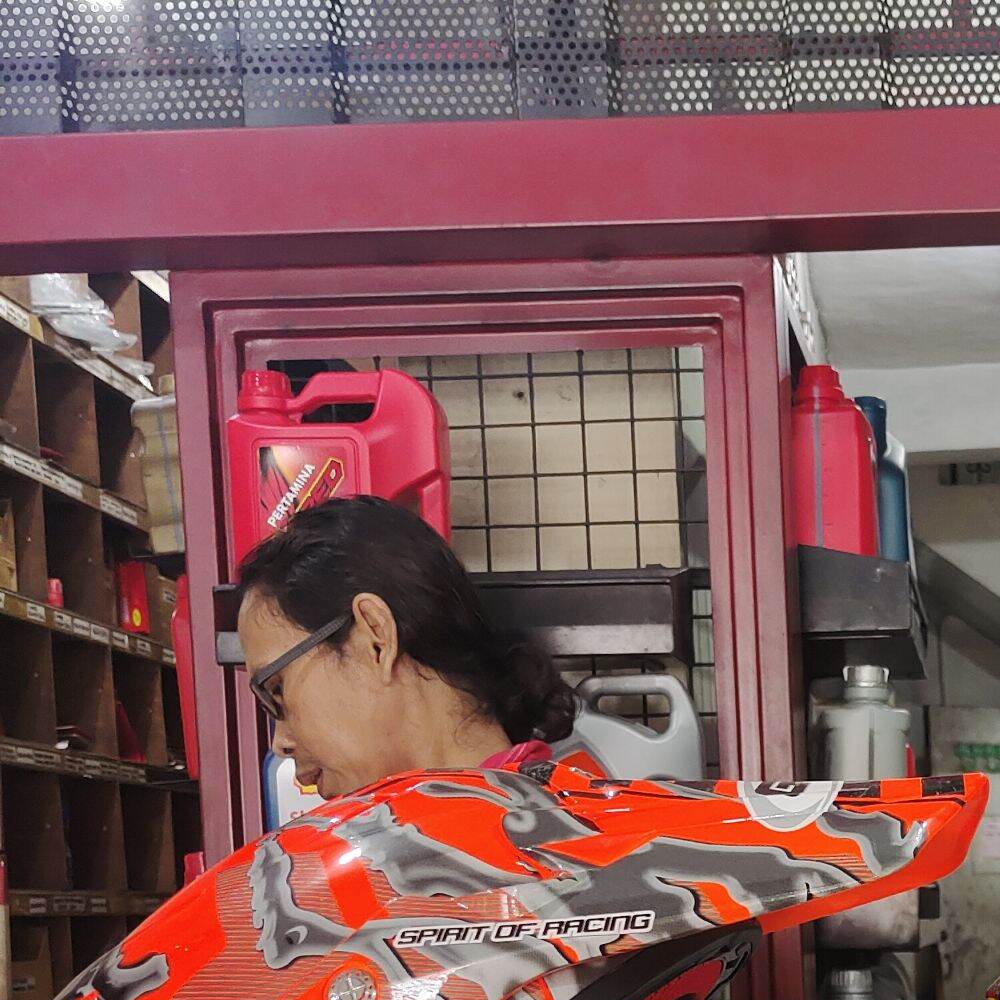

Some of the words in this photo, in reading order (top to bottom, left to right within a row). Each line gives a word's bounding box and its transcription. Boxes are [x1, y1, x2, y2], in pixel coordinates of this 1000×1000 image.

[267, 464, 315, 527] PERTAMINA
[400, 925, 490, 945] SPIRIT
[495, 922, 537, 940] OF
[542, 913, 652, 937] RACING
